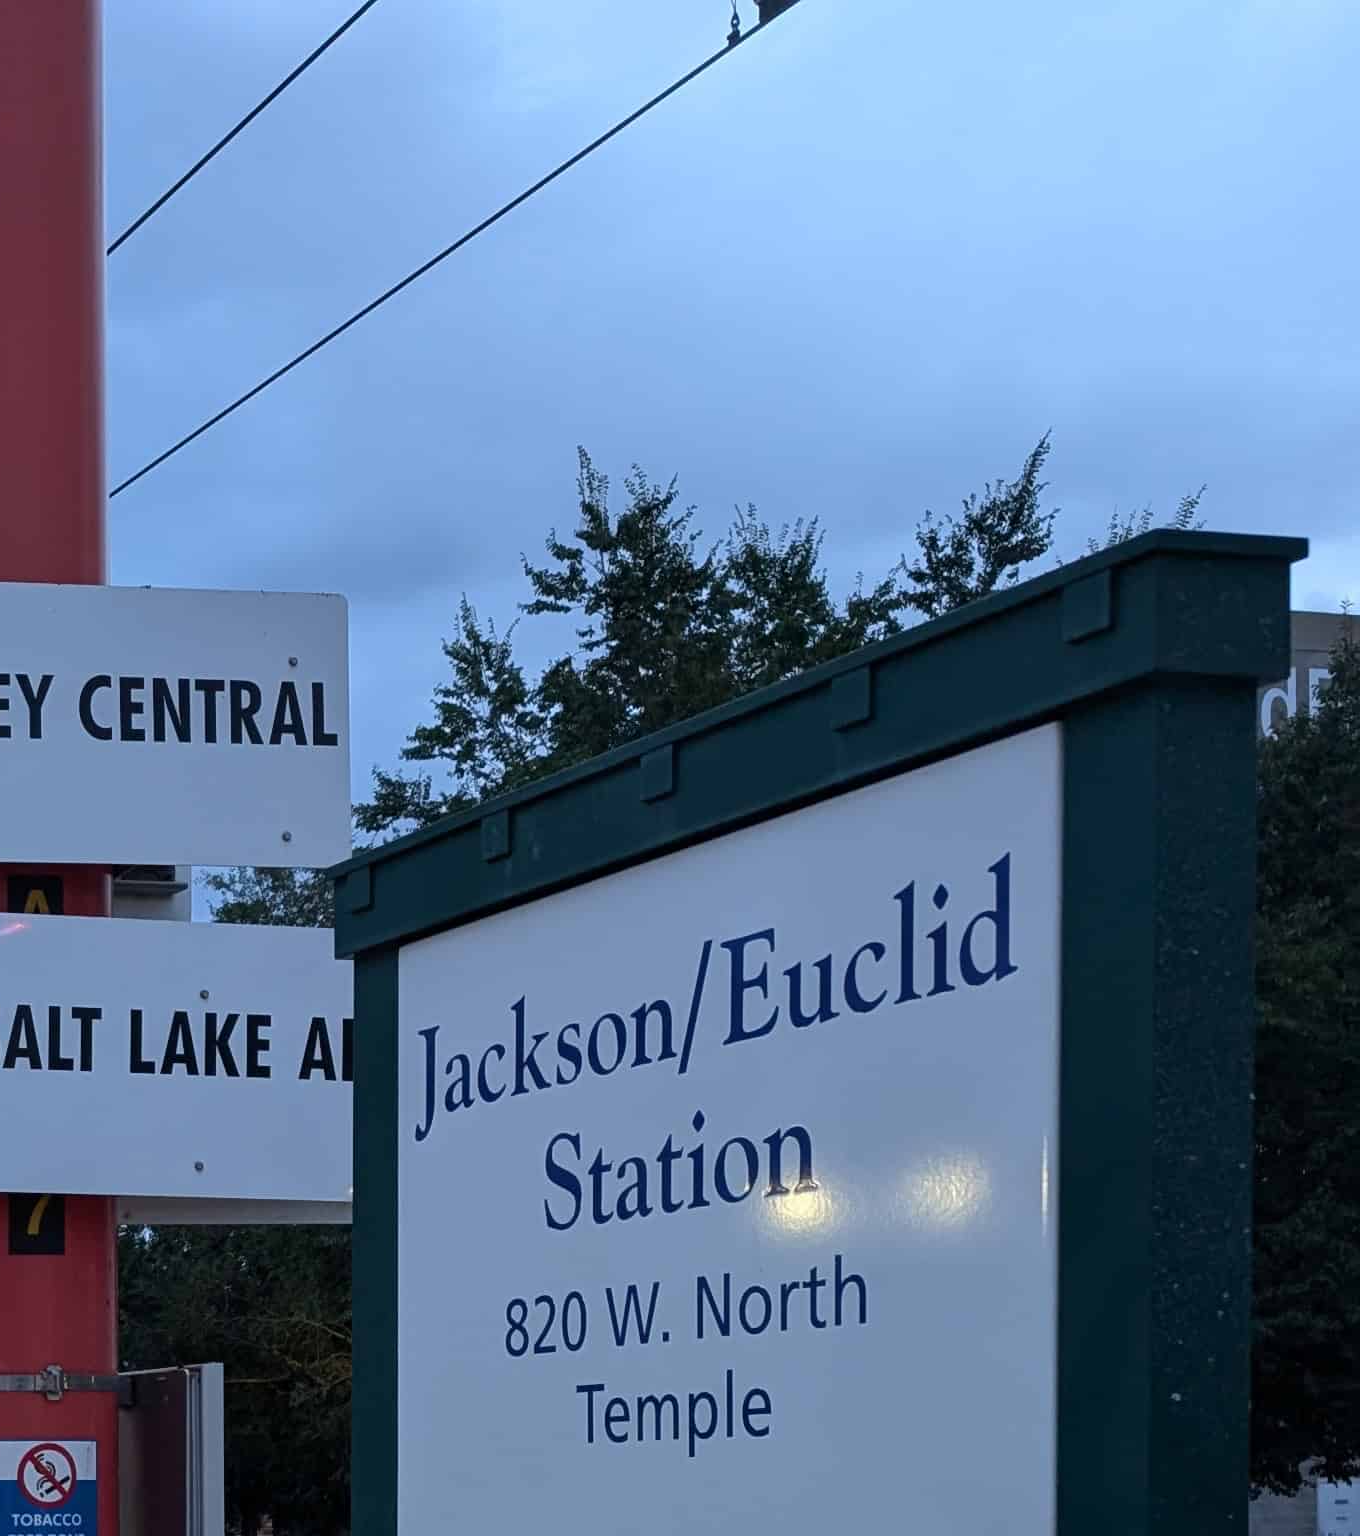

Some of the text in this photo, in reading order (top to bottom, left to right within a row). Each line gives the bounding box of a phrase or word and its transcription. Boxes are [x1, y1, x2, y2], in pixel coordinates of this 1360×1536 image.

[79, 674, 338, 746] CENTRAL
[415, 852, 1018, 1142] Jackson/Euclid
[130, 1009, 271, 1078] LAKE
[544, 1109, 821, 1231] Station
[506, 1254, 868, 1357] 820 W. North
[576, 1369, 773, 1458] Temple
[11, 1513, 82, 1526] TOBACCO
